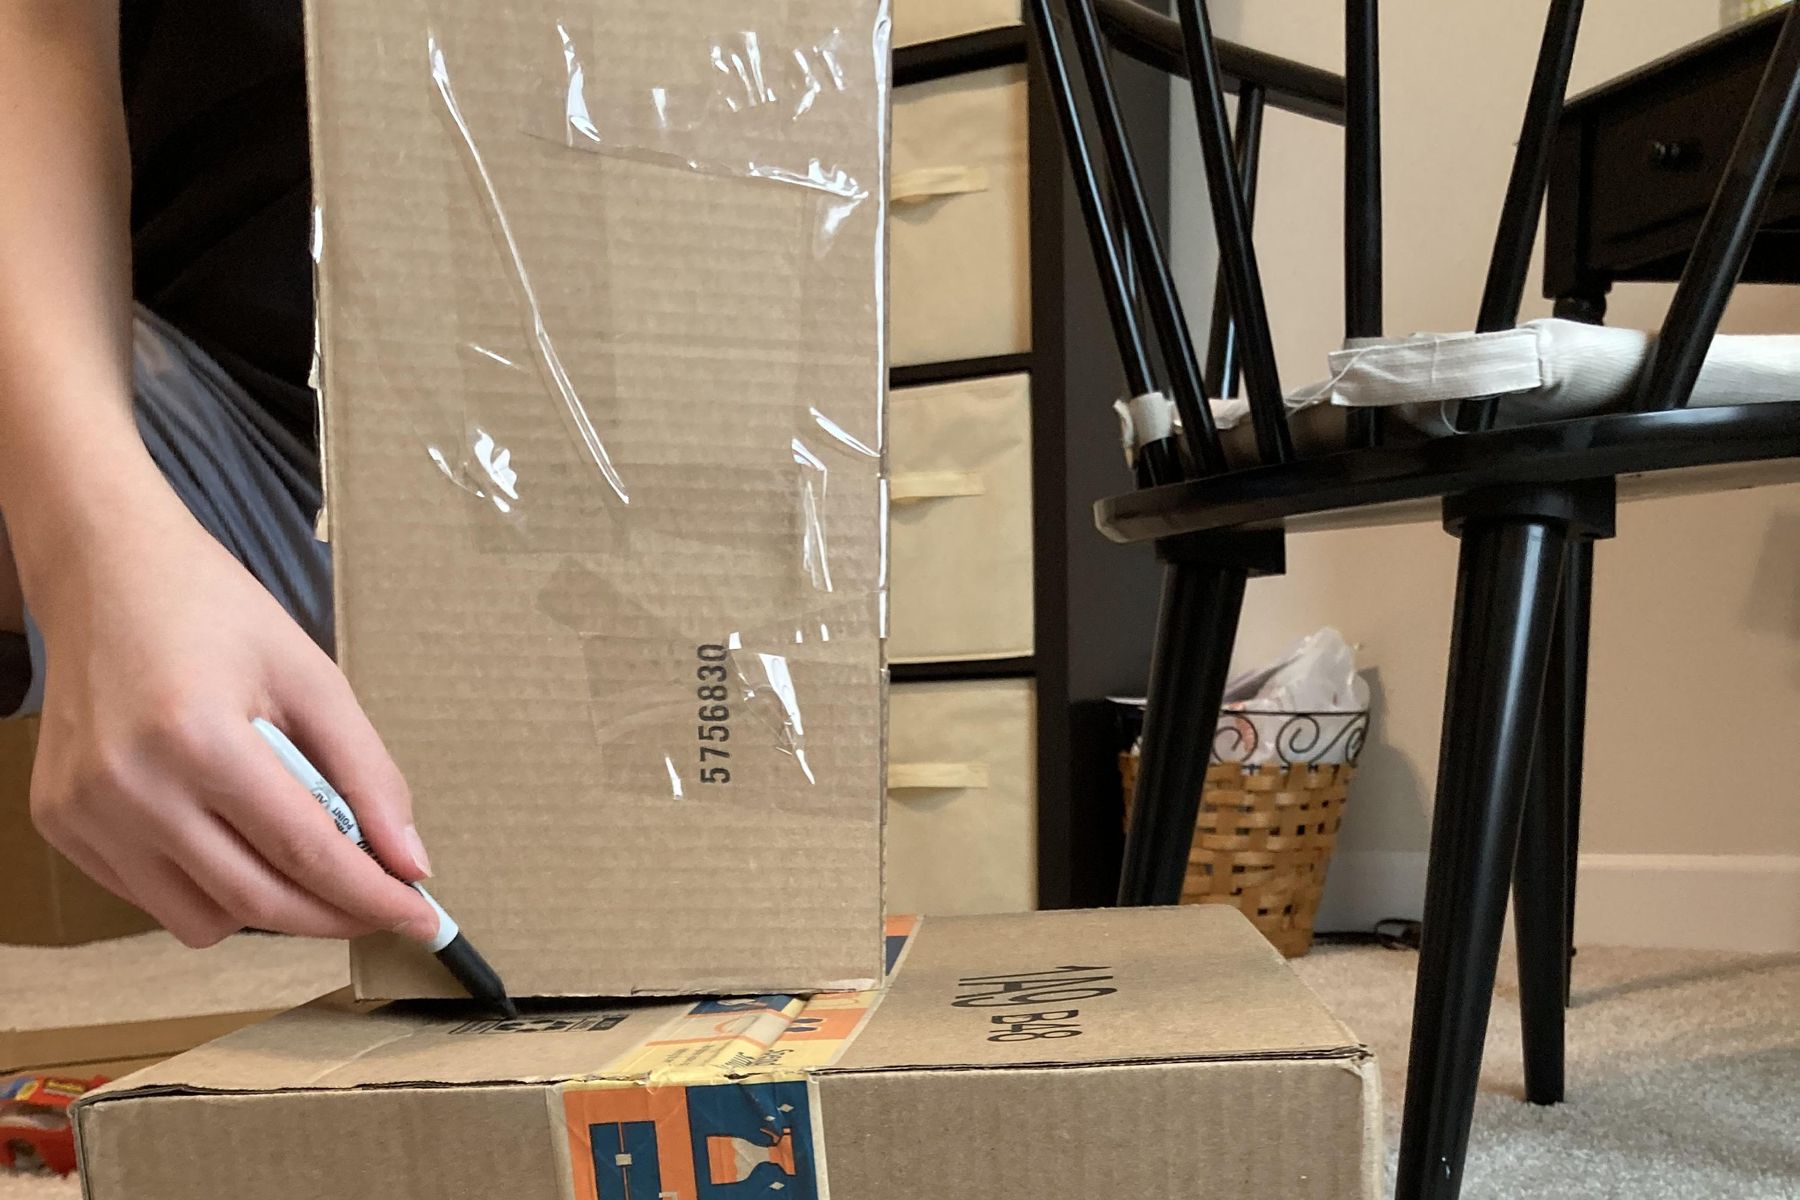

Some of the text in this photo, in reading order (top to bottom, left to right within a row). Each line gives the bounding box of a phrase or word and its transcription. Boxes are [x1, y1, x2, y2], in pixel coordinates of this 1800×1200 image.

[697, 643, 731, 784] 5756830
[331, 806, 354, 831] POINT
[951, 965, 1118, 1043] 1A9 B48
